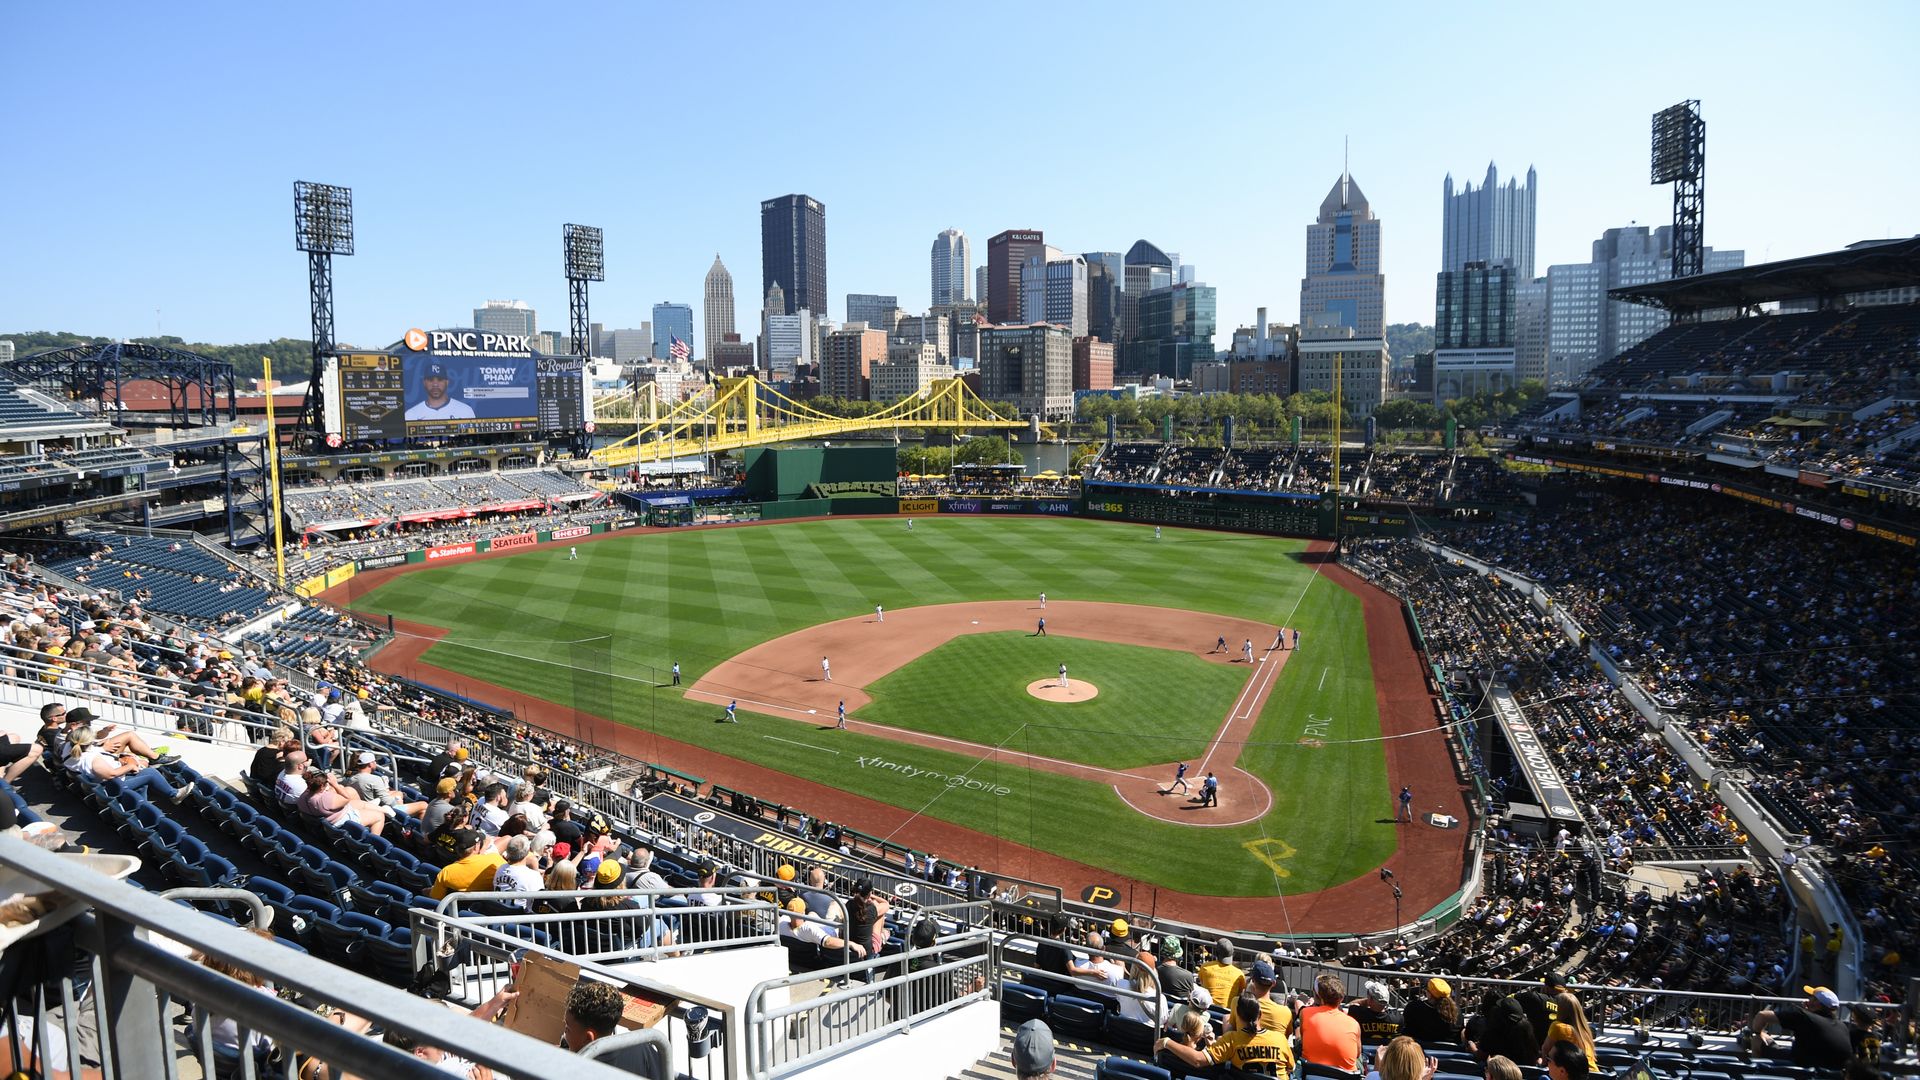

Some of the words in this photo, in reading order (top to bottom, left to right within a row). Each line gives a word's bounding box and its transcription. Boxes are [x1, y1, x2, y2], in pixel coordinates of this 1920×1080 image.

[430, 332, 477, 351] PNC
[481, 334, 531, 352] PARK
[390, 357, 400, 369] P
[546, 358, 582, 373] Royals
[812, 481, 895, 499] PIRATES
[1660, 476, 1688, 486] CELLONE'S
[1690, 481, 1709, 490] BREAD
[912, 502, 936, 511] LIGHT
[948, 501, 976, 512] xfinity
[1050, 504, 1068, 512] AHN
[1088, 501, 1123, 512] bet365
[9, 514, 56, 529] HOMETOWN
[57, 510, 90, 520] FAVORITE
[1796, 506, 1820, 520] CELLONE'S
[1820, 513, 1838, 525] BREAD
[553, 527, 590, 539] SHEETZ
[1856, 523, 1876, 535] BAKED
[1876, 528, 1897, 541] FRESH
[1896, 533, 1917, 546] DAILY
[494, 536, 534, 550] SEATGEEK
[344, 712, 354, 720] 21
[1304, 714, 1332, 736] PNC
[1514, 732, 1535, 743] TO
[1521, 743, 1561, 789] WELCOME
[855, 756, 925, 778] xfinity
[925, 771, 1010, 796] mobile
[754, 833, 842, 869] PIRATES
[496, 875, 518, 890] SKENES
[1088, 886, 1114, 904] P
[1362, 1022, 1399, 1034] CLEMENTE
[1237, 1046, 1280, 1060] CLEMENTE
